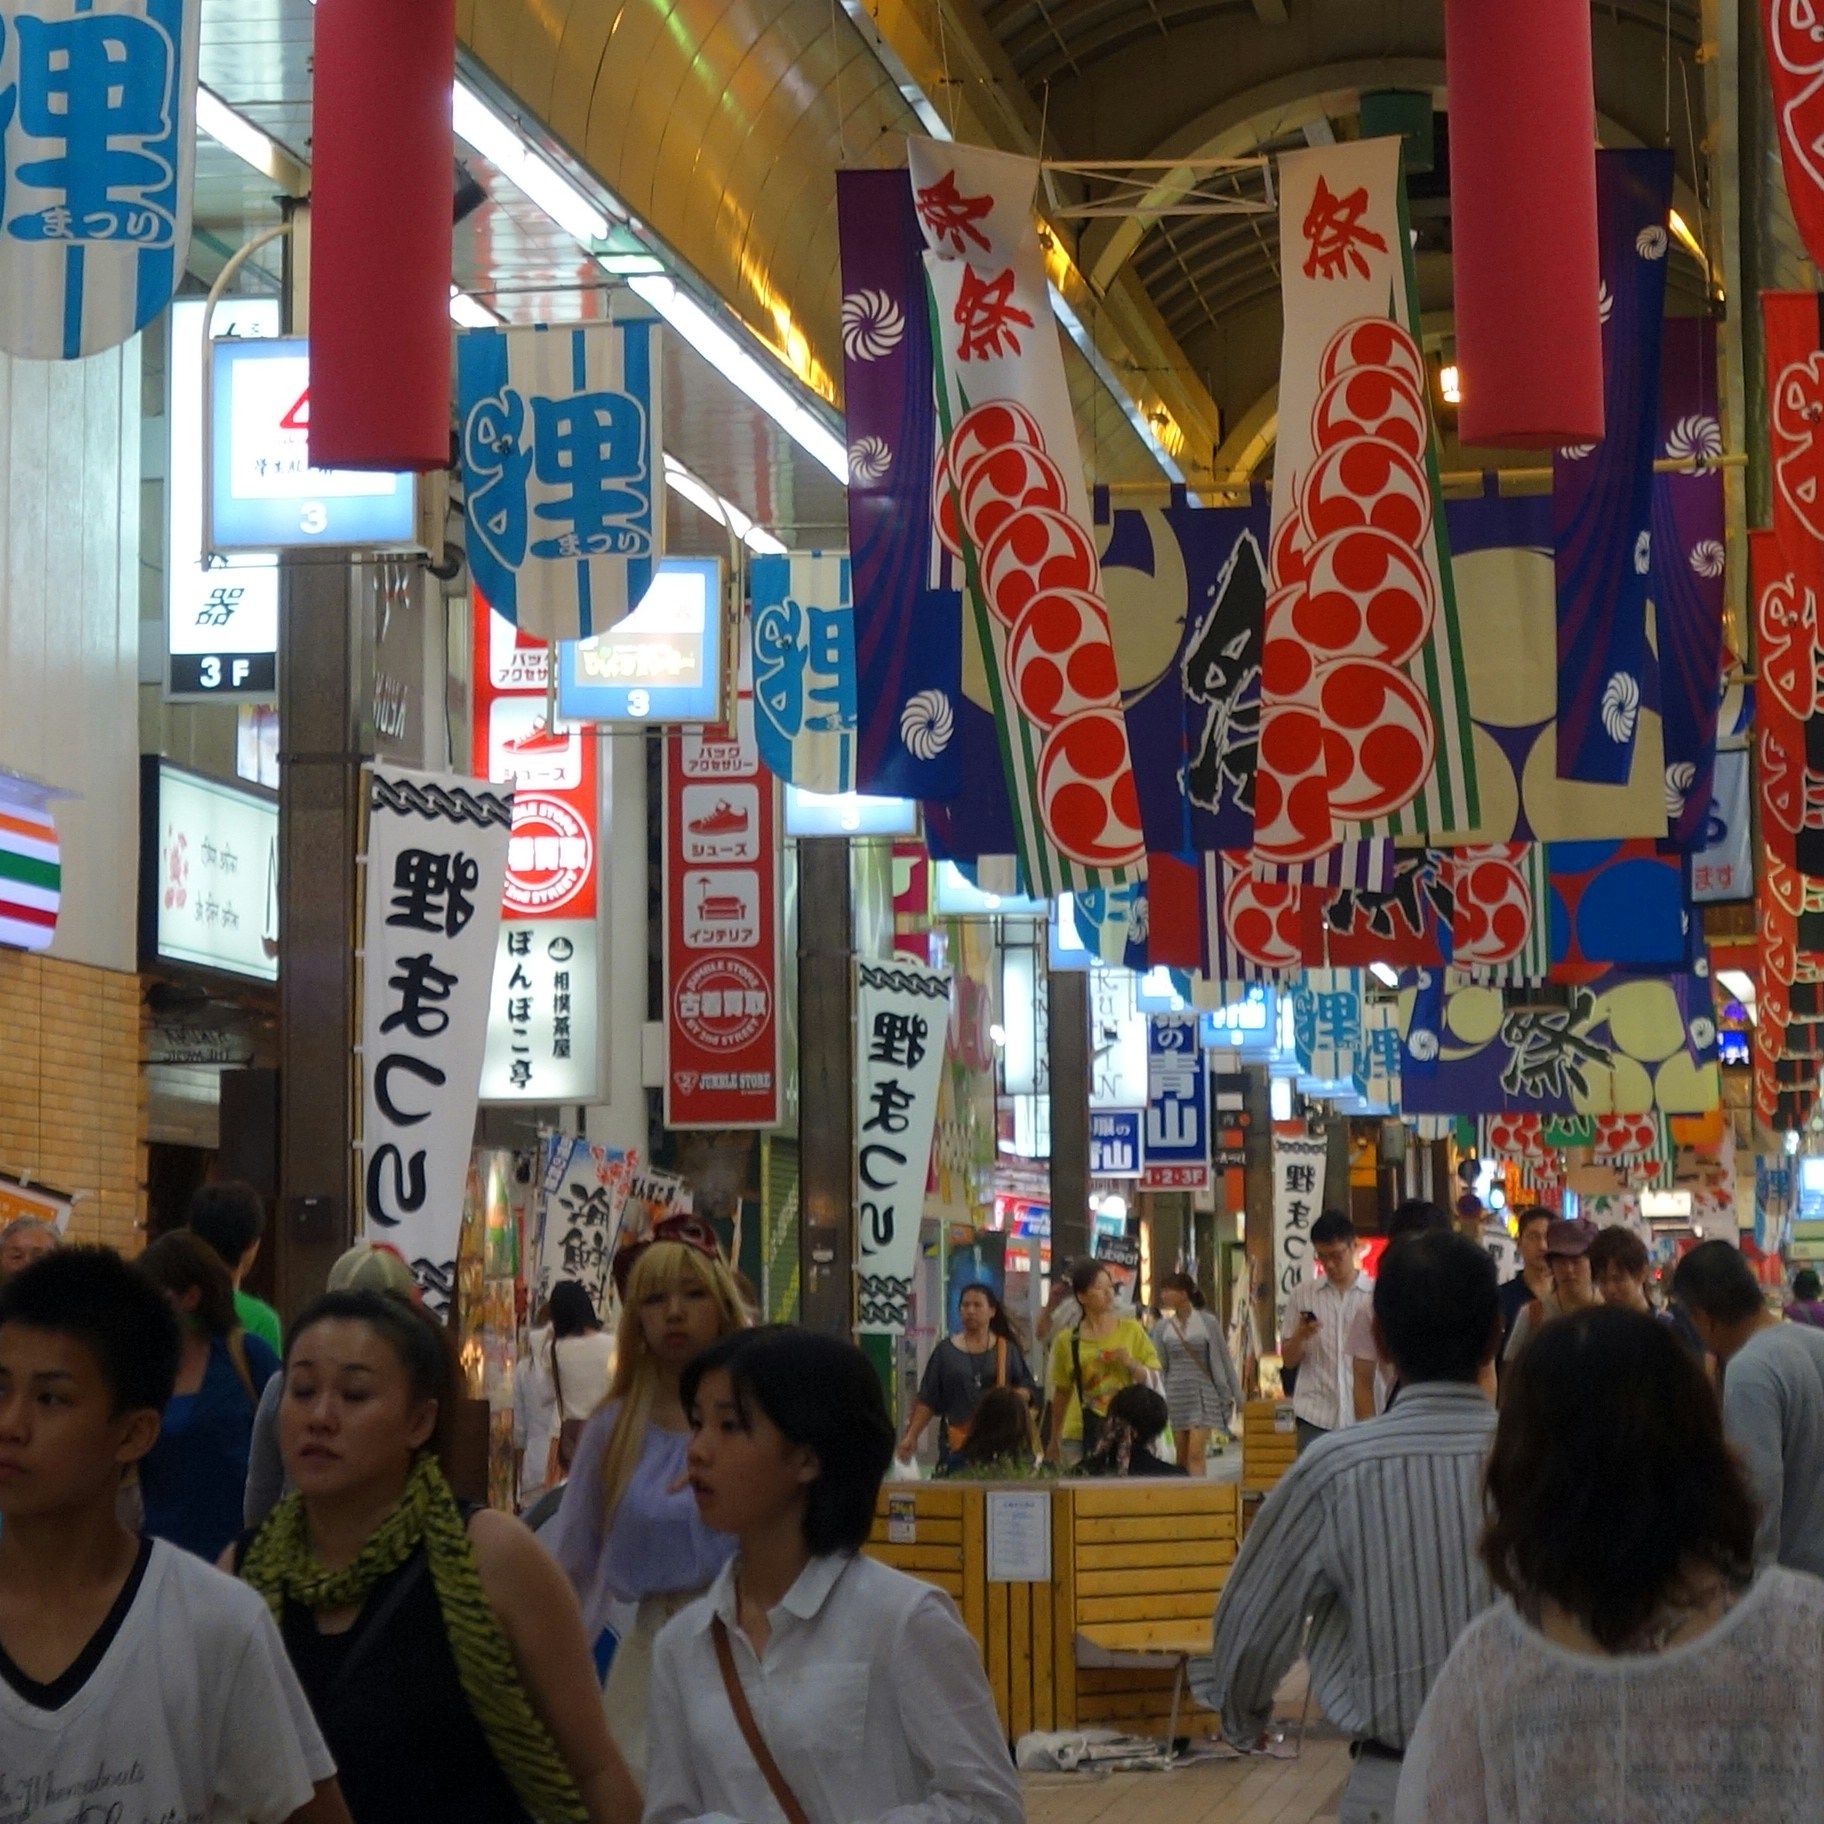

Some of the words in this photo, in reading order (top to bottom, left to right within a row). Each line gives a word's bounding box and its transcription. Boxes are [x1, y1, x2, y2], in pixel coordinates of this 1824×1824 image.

[44, 205, 159, 242] まつり
[914, 169, 994, 259] 祭
[1301, 173, 1388, 282] 祭
[953, 266, 1035, 362] 祭
[299, 501, 329, 535] 3
[554, 531, 642, 558] まつり
[199, 657, 251, 690] 3F
[626, 688, 650, 716] 3
[691, 841, 749, 857] シューズ
[689, 928, 753, 944] インテリア
